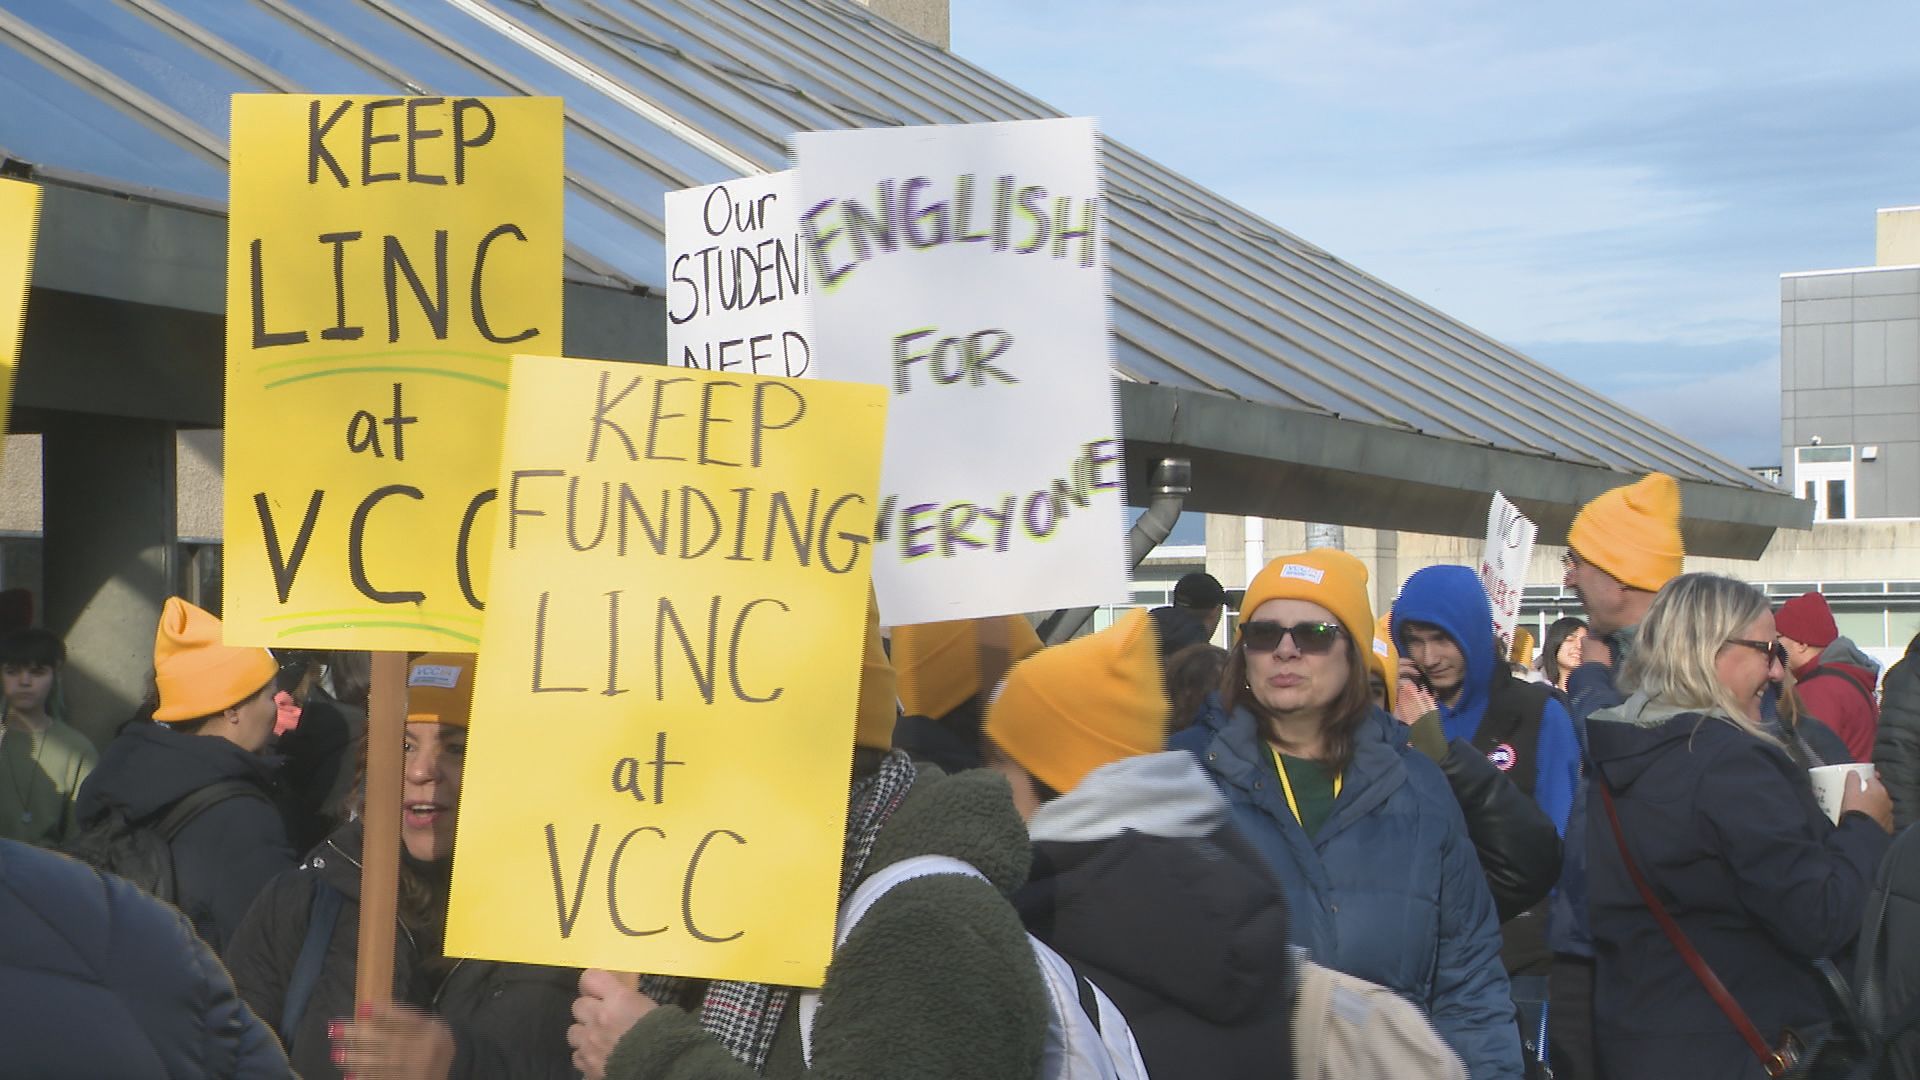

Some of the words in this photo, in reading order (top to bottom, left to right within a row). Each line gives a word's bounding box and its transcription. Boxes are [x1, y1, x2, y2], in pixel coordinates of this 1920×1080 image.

[308, 97, 496, 188] KEEP
[703, 185, 777, 236] Our
[799, 173, 1099, 294] ENGLISH
[250, 223, 540, 349] LINC
[893, 325, 1019, 394] FOR
[346, 382, 418, 461] at
[586, 370, 807, 468] KEEP
[252, 484, 498, 611] VCC
[508, 469, 871, 574] FUNDING
[531, 590, 791, 705] LINC
[611, 731, 686, 804] at
[544, 822, 747, 943] VCC
